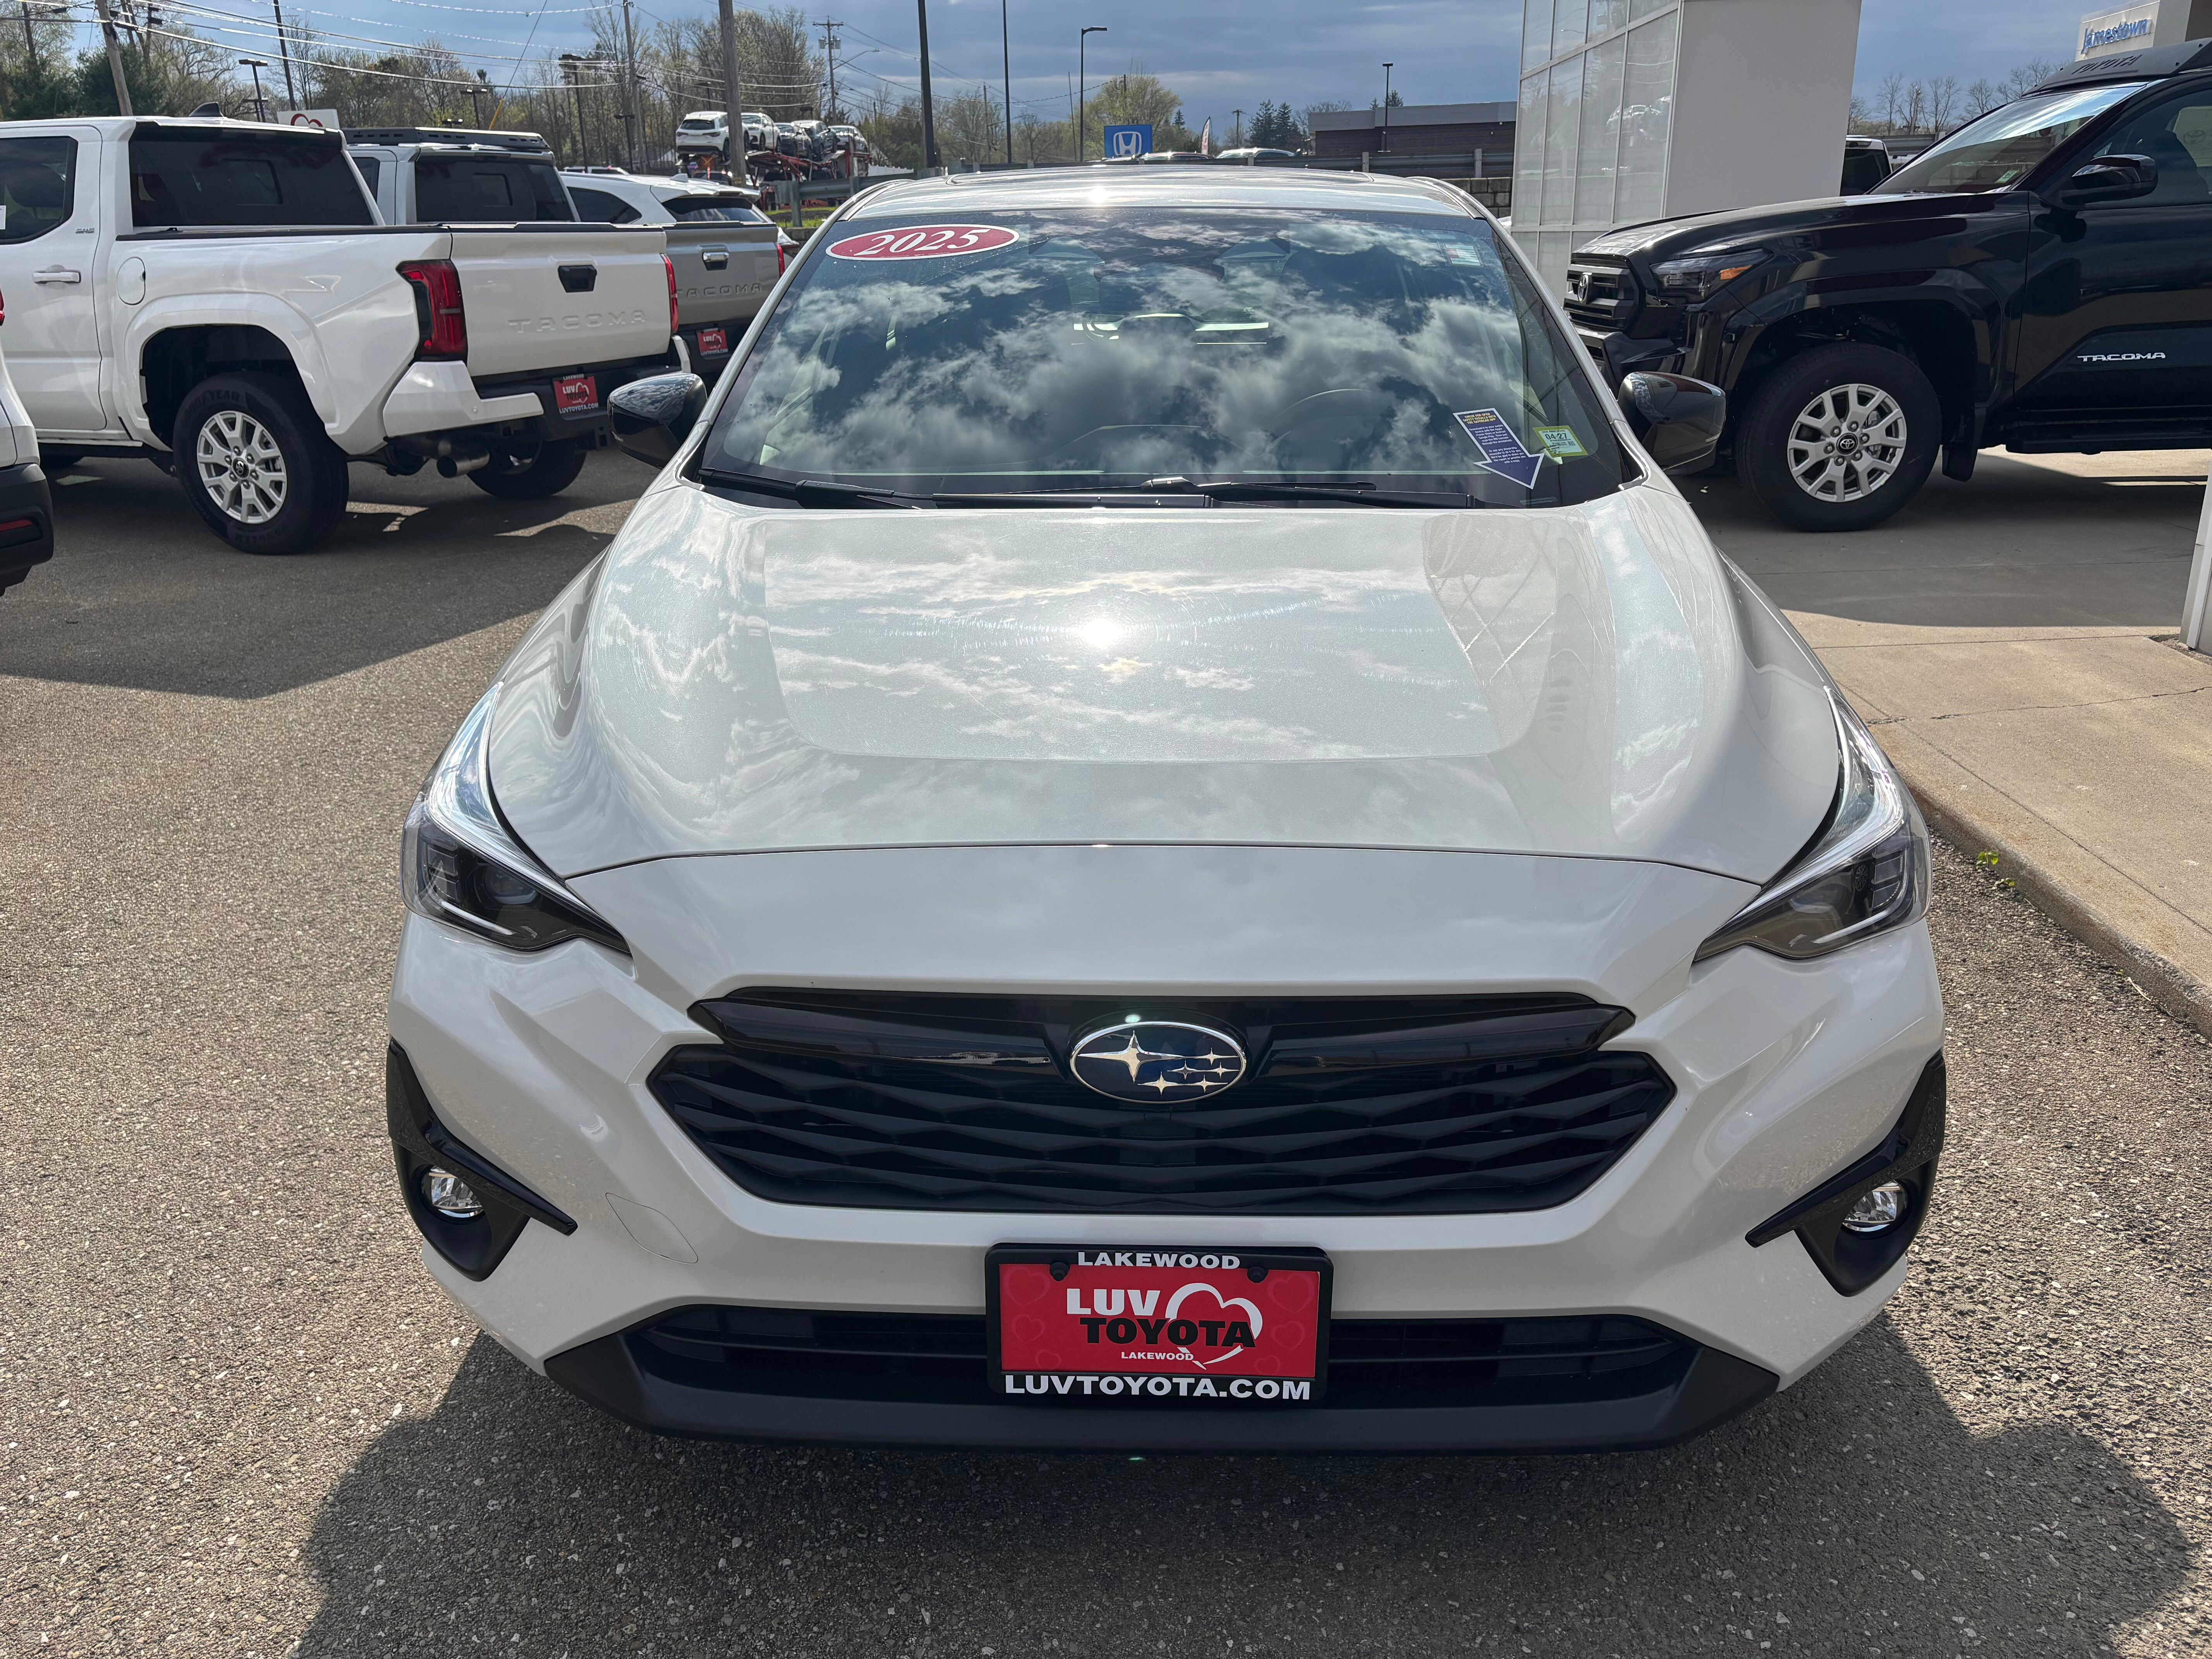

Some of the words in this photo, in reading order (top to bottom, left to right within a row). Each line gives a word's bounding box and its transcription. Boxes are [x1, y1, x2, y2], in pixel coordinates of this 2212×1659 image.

[2081, 19, 2148, 54] Jamestown
[853, 228, 991, 256] 2025
[508, 310, 646, 333] TACOMA
[2077, 352, 2166, 362] TACOMA
[562, 385, 575, 394] LUV
[559, 402, 599, 414] LUVTOYOTA.COM
[1078, 1252, 1240, 1269] LAKEWOOD
[1067, 1288, 1161, 1316] LUV
[1080, 1317, 1255, 1348] TOYOTA
[1121, 1351, 1194, 1361] LAKEWOOD
[1005, 1375, 1310, 1400] LUVTOYOTA.COM
